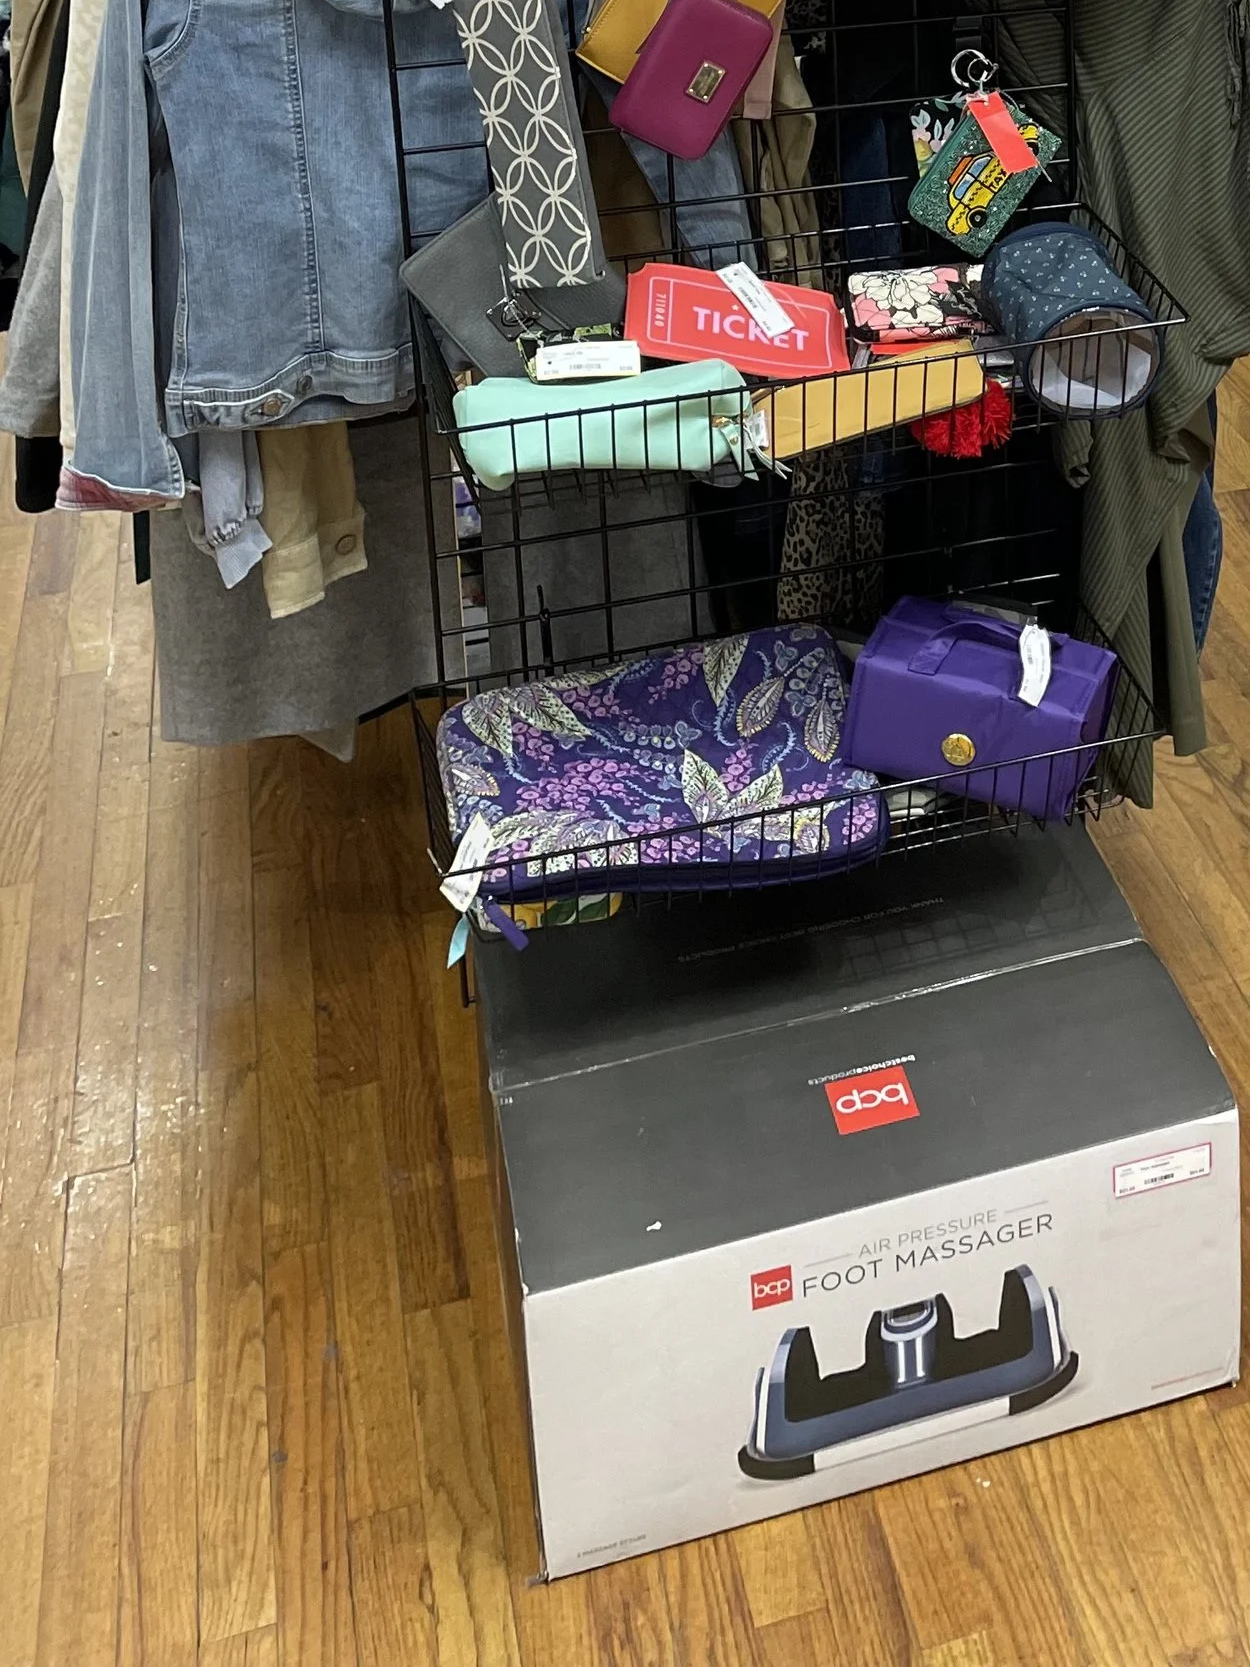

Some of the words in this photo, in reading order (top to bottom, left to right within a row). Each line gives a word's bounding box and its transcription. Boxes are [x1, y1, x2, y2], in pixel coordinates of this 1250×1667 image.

[836, 1082, 909, 1114] bcp
[858, 1237, 891, 1259] AIR
[898, 1209, 998, 1247] PRESSURE
[802, 1258, 883, 1298] FOOT
[895, 1213, 1054, 1273] MASSAGER
[753, 1277, 790, 1299] bcp
